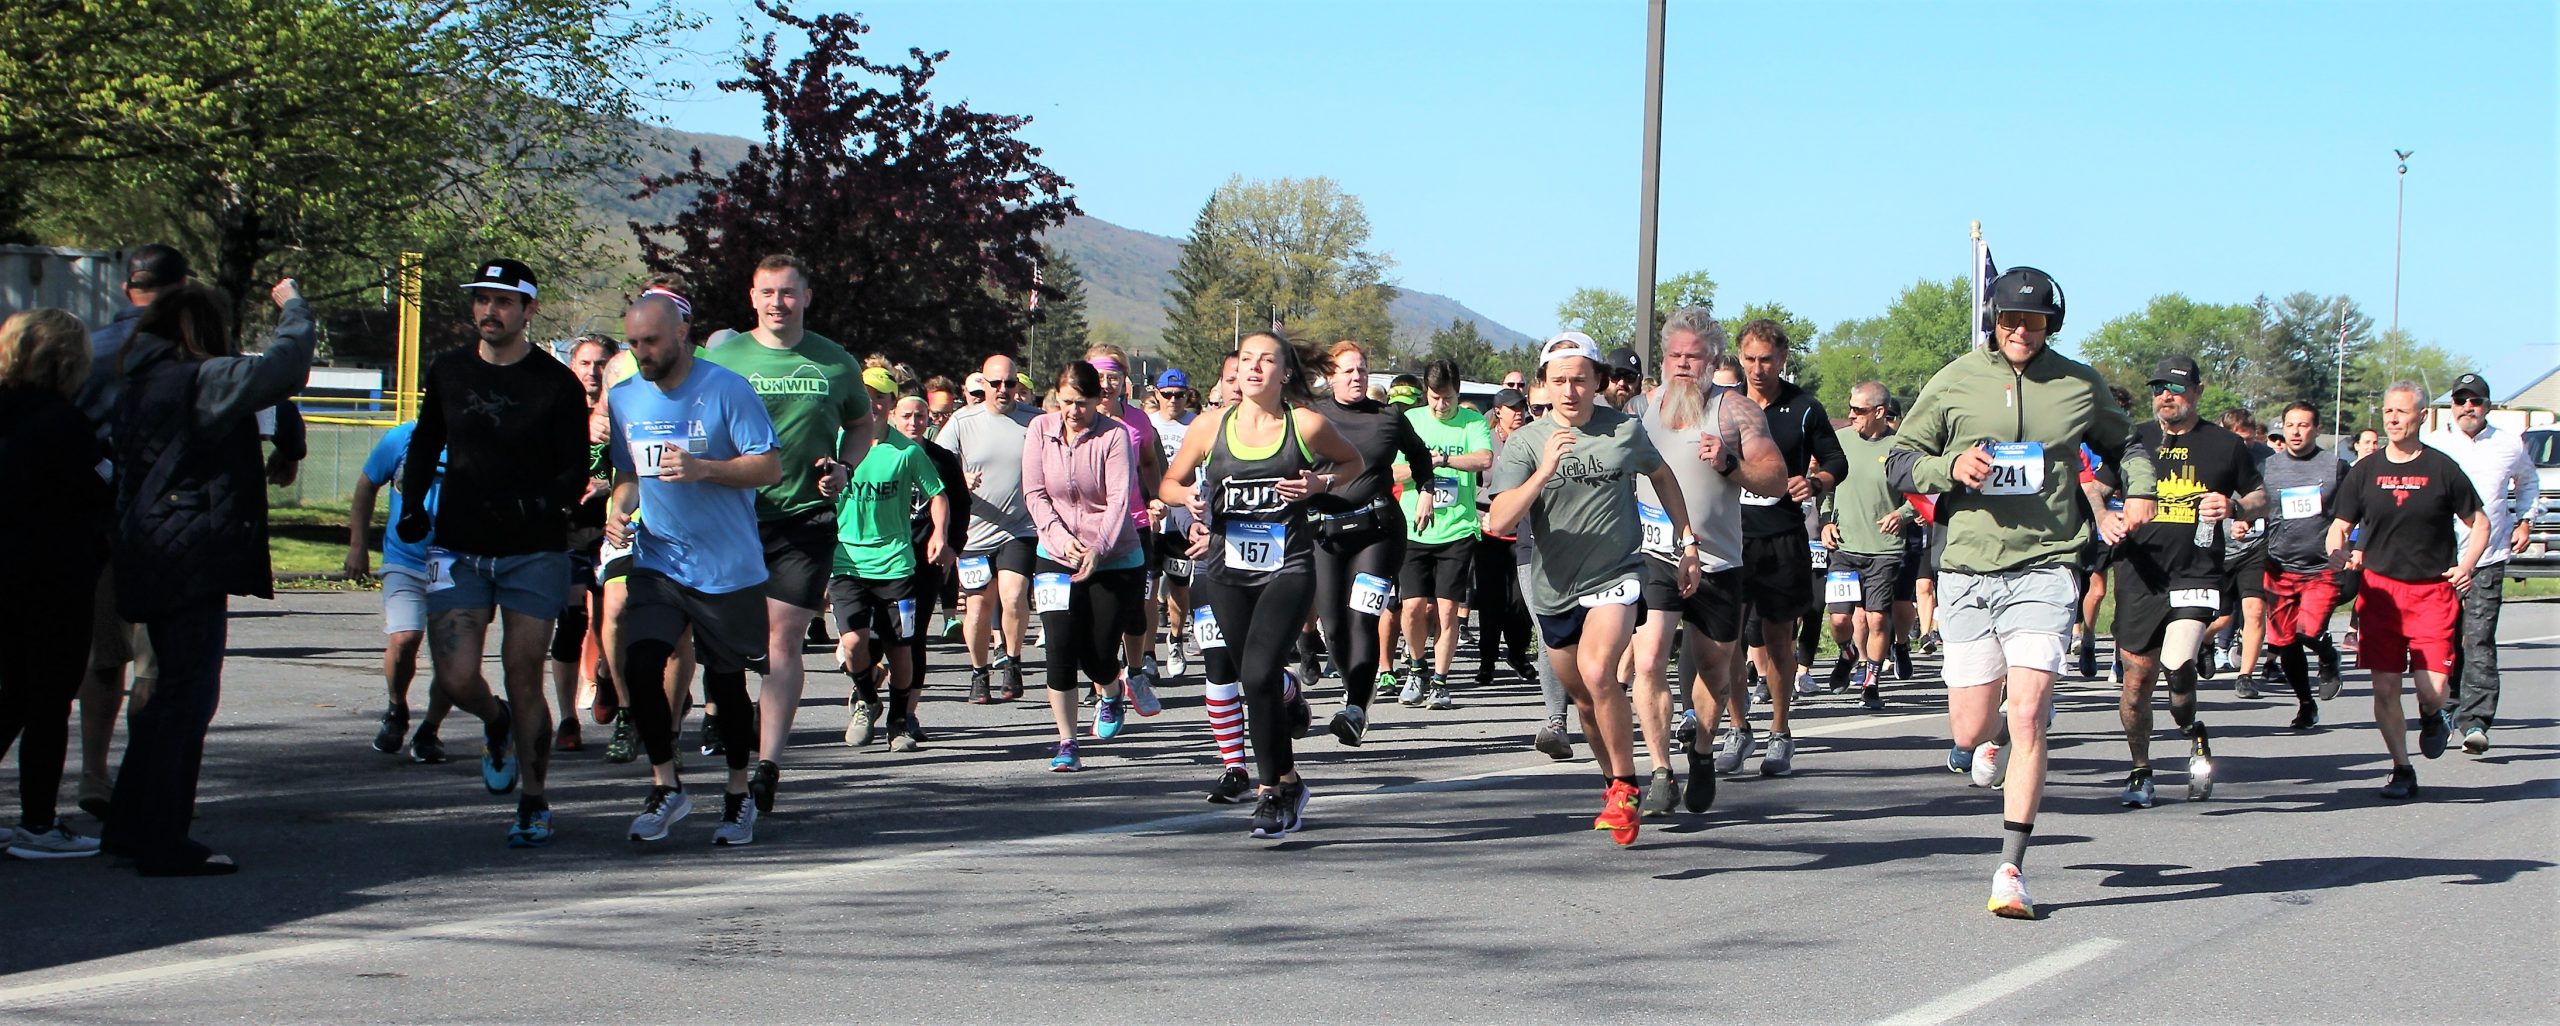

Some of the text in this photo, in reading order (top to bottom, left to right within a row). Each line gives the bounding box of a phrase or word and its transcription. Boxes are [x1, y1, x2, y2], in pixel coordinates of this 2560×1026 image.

[752, 380, 828, 392] RUN WILD
[645, 444, 670, 468] 17
[1992, 465, 2028, 488] 241
[1228, 486, 1279, 506] run
[2292, 498, 2312, 513] 155
[1239, 541, 1270, 564] 157
[1168, 558, 1187, 574] 137
[964, 569, 985, 585] 222
[1037, 588, 1057, 607] 133
[1833, 583, 1852, 598] 181
[1361, 591, 1385, 611] 129
[1200, 622, 1225, 643] 132
